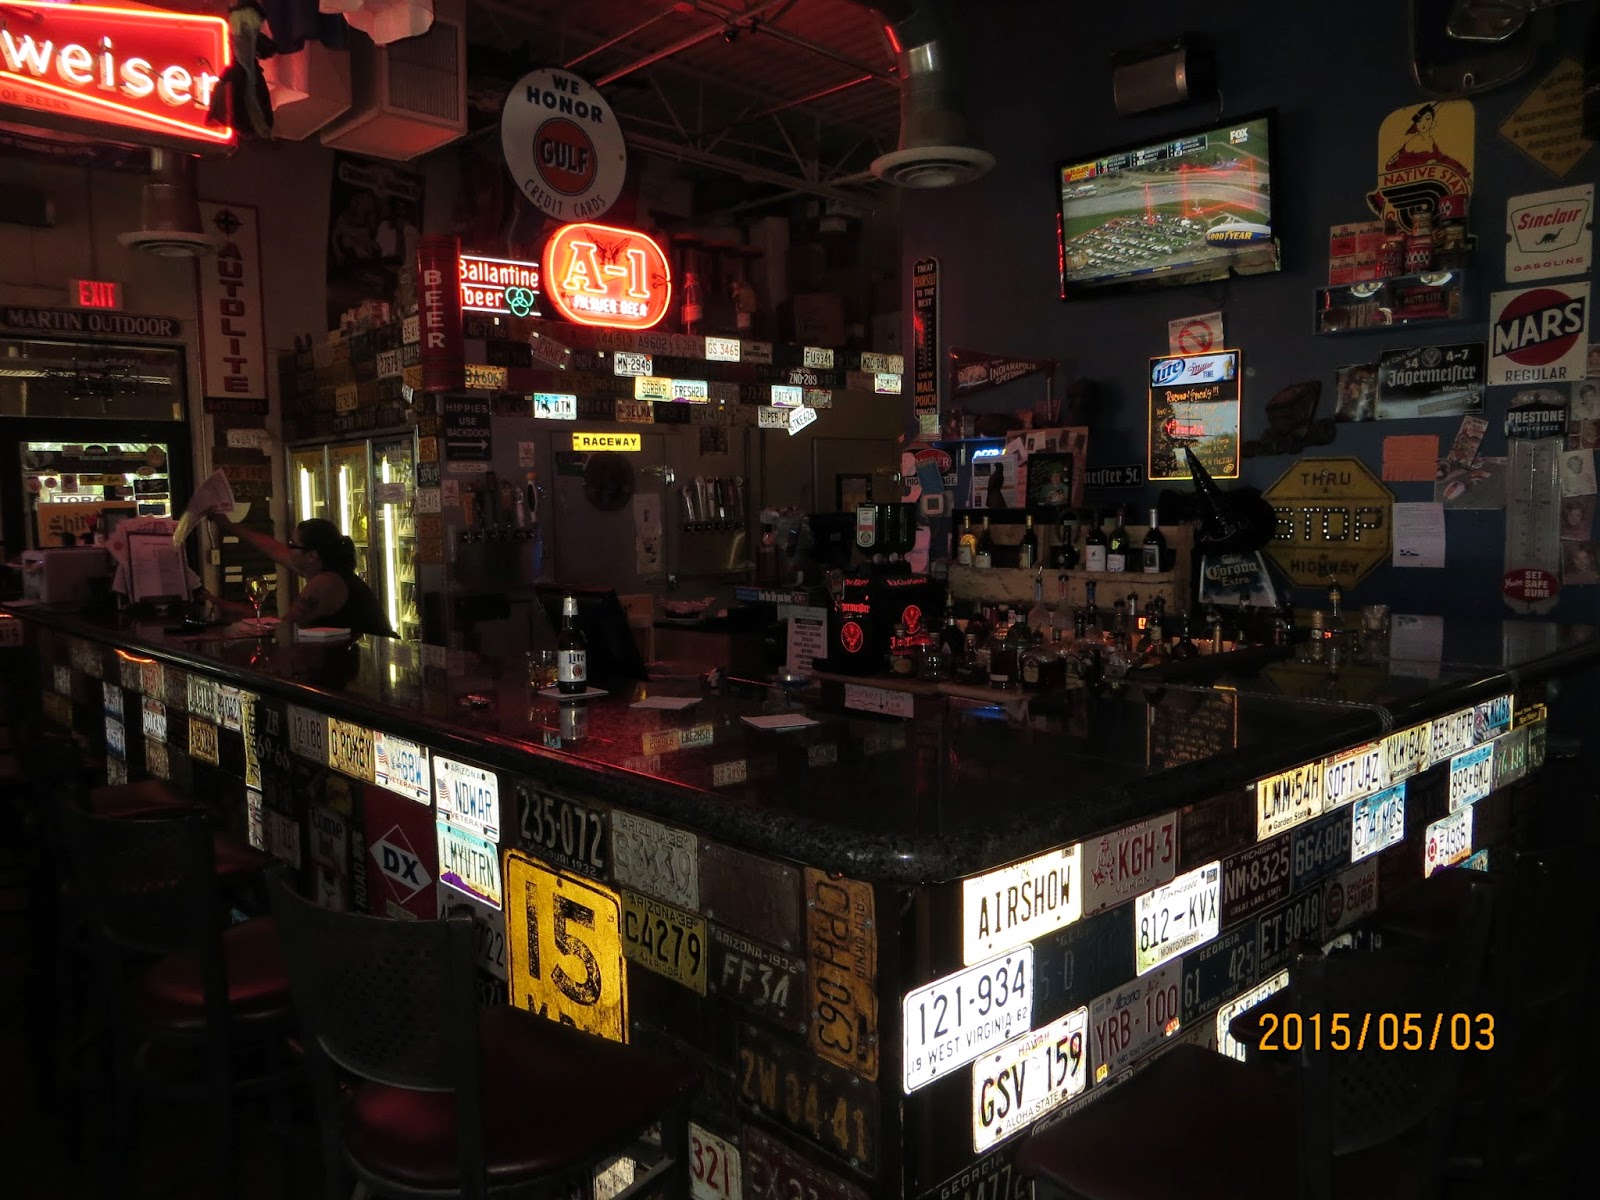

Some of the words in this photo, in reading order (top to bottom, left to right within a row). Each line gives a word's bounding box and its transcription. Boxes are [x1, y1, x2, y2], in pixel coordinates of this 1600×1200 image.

[552, 74, 580, 95] WE
[527, 86, 603, 123] HONOR
[1229, 127, 1249, 141] FOX
[540, 138, 590, 175] GULF
[1383, 167, 1437, 186] NATIVE
[524, 179, 564, 216] CREDIT
[573, 194, 607, 218] CARDS
[1517, 206, 1583, 231] Sinclair
[461, 261, 540, 288] Ballantine
[562, 240, 651, 299] A-1
[917, 262, 935, 274] TREAT
[1513, 256, 1585, 273] GASOLINE
[78, 279, 117, 308] EXIT
[463, 288, 504, 307] beer
[918, 298, 933, 308] BEST
[217, 242, 250, 393] AUTOLITE
[423, 269, 446, 349] BEER
[619, 299, 649, 317] BEER
[8, 309, 83, 330] MARTIN
[88, 315, 173, 336] OUTDOOR
[1494, 303, 1584, 355] MARS
[535, 339, 566, 361] JENNER
[707, 342, 718, 355] GS
[720, 343, 739, 357] 3465
[617, 357, 651, 372] MN-2946
[1153, 361, 1181, 383] Lite
[1505, 366, 1568, 383] REGULAR
[916, 381, 935, 394] MAIL
[1387, 364, 1478, 389] Jägermeister
[674, 385, 705, 398] FRESH2U
[915, 394, 937, 407] POUCH
[446, 402, 488, 414] HIPPIES
[1506, 408, 1566, 424] PRESTONE
[447, 427, 491, 438] BACKDOOR
[459, 417, 477, 426] USE
[1511, 424, 1561, 434] ANTI-FREEZE
[582, 437, 637, 447] RACEWAY
[1300, 471, 1352, 487] THRU
[1272, 507, 1385, 542] STOP
[1205, 562, 1259, 581] Corona
[1290, 558, 1361, 577] HIGHWAY
[1524, 570, 1544, 580] SET
[1221, 576, 1250, 588] Extra
[1524, 579, 1549, 590] SAFE
[1524, 588, 1551, 599] SURE
[568, 652, 585, 665] Lite
[340, 730, 375, 772] POKEY
[451, 763, 482, 780] ARIZONA
[1327, 760, 1356, 801] SOFT
[1357, 752, 1380, 789] JAZ
[388, 775, 417, 791] VETERAN
[455, 779, 493, 824] NDWAR
[450, 811, 486, 829] VETERAN
[1273, 815, 1294, 830] Garden
[1294, 809, 1308, 823] State
[451, 829, 484, 848] ARIZONA
[1240, 840, 1277, 863] MICHIGAN
[381, 845, 421, 887] DX
[442, 837, 495, 890] LMYUTRN
[571, 859, 598, 877] 1932
[1114, 875, 1151, 896] YUKON
[1158, 879, 1199, 905] Tennessee
[978, 864, 1072, 941] AIRSHOW
[1230, 901, 1250, 916] GREAT
[1250, 893, 1266, 908] LAKE
[1140, 886, 1218, 953] 812-KVX
[524, 879, 601, 1007] 15
[625, 910, 701, 976] C4279
[852, 891, 867, 981] CALIFORNIA
[1160, 933, 1199, 958] MONTGOMERY
[1200, 933, 1240, 961] GEORGIA
[1260, 912, 1284, 960] ET
[918, 959, 1026, 1046] 121-934
[1111, 988, 1141, 1013] Alberta
[926, 1039, 961, 1067] WEST
[966, 1011, 1013, 1048] VIRGINIA
[980, 1056, 1027, 1128] GSV
[1045, 1031, 1083, 1094] 159
[1005, 1106, 1035, 1130] ALOHA
[1035, 1090, 1060, 1114] STATE
[691, 1136, 731, 1197] 321
